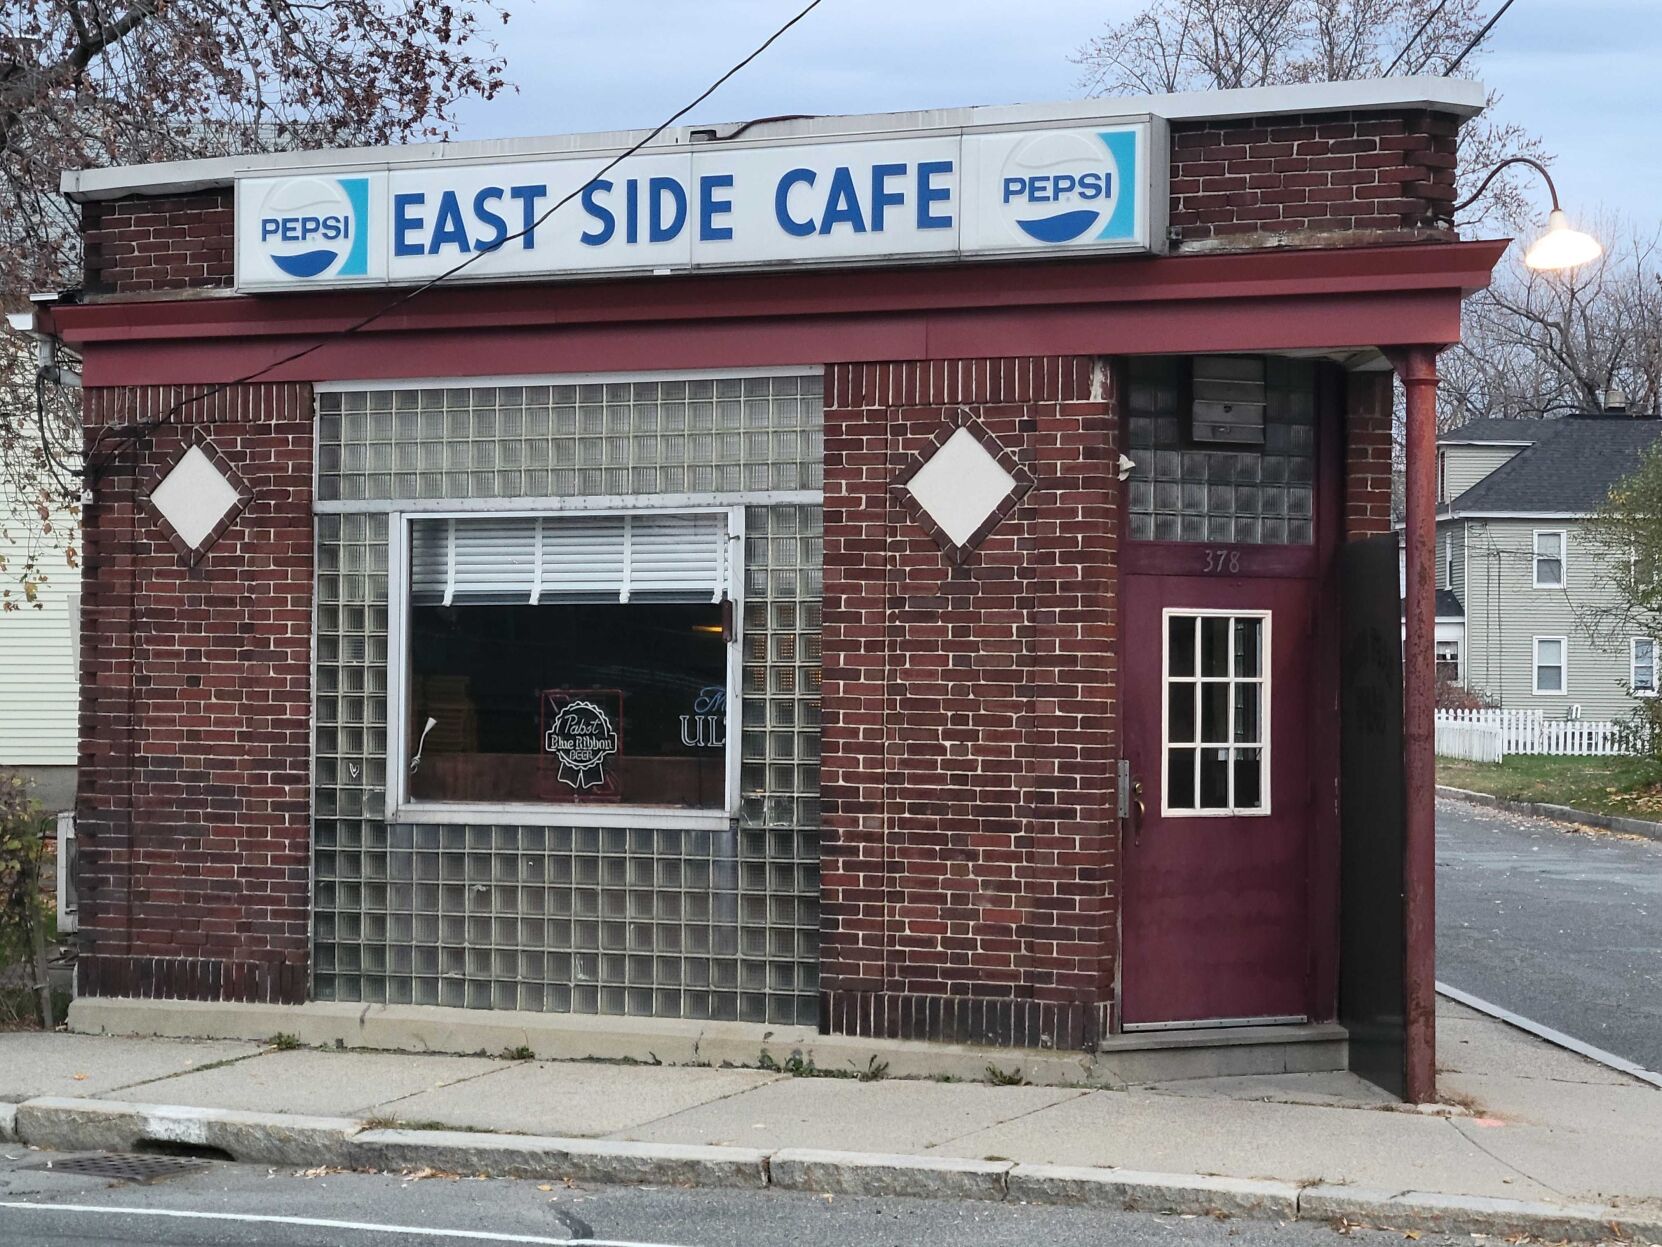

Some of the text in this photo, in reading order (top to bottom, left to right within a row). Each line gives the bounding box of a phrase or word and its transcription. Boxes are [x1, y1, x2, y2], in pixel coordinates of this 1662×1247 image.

[1003, 172, 1112, 204] PEPSI
[394, 160, 953, 257] EAST SIDE CAFE
[261, 215, 349, 242] PEPSI
[1203, 549, 1241, 573] 378
[564, 714, 602, 735] Pabst
[679, 715, 726, 747] UL
[550, 734, 614, 750] Blue Ribbon
[569, 750, 594, 761] BEER
